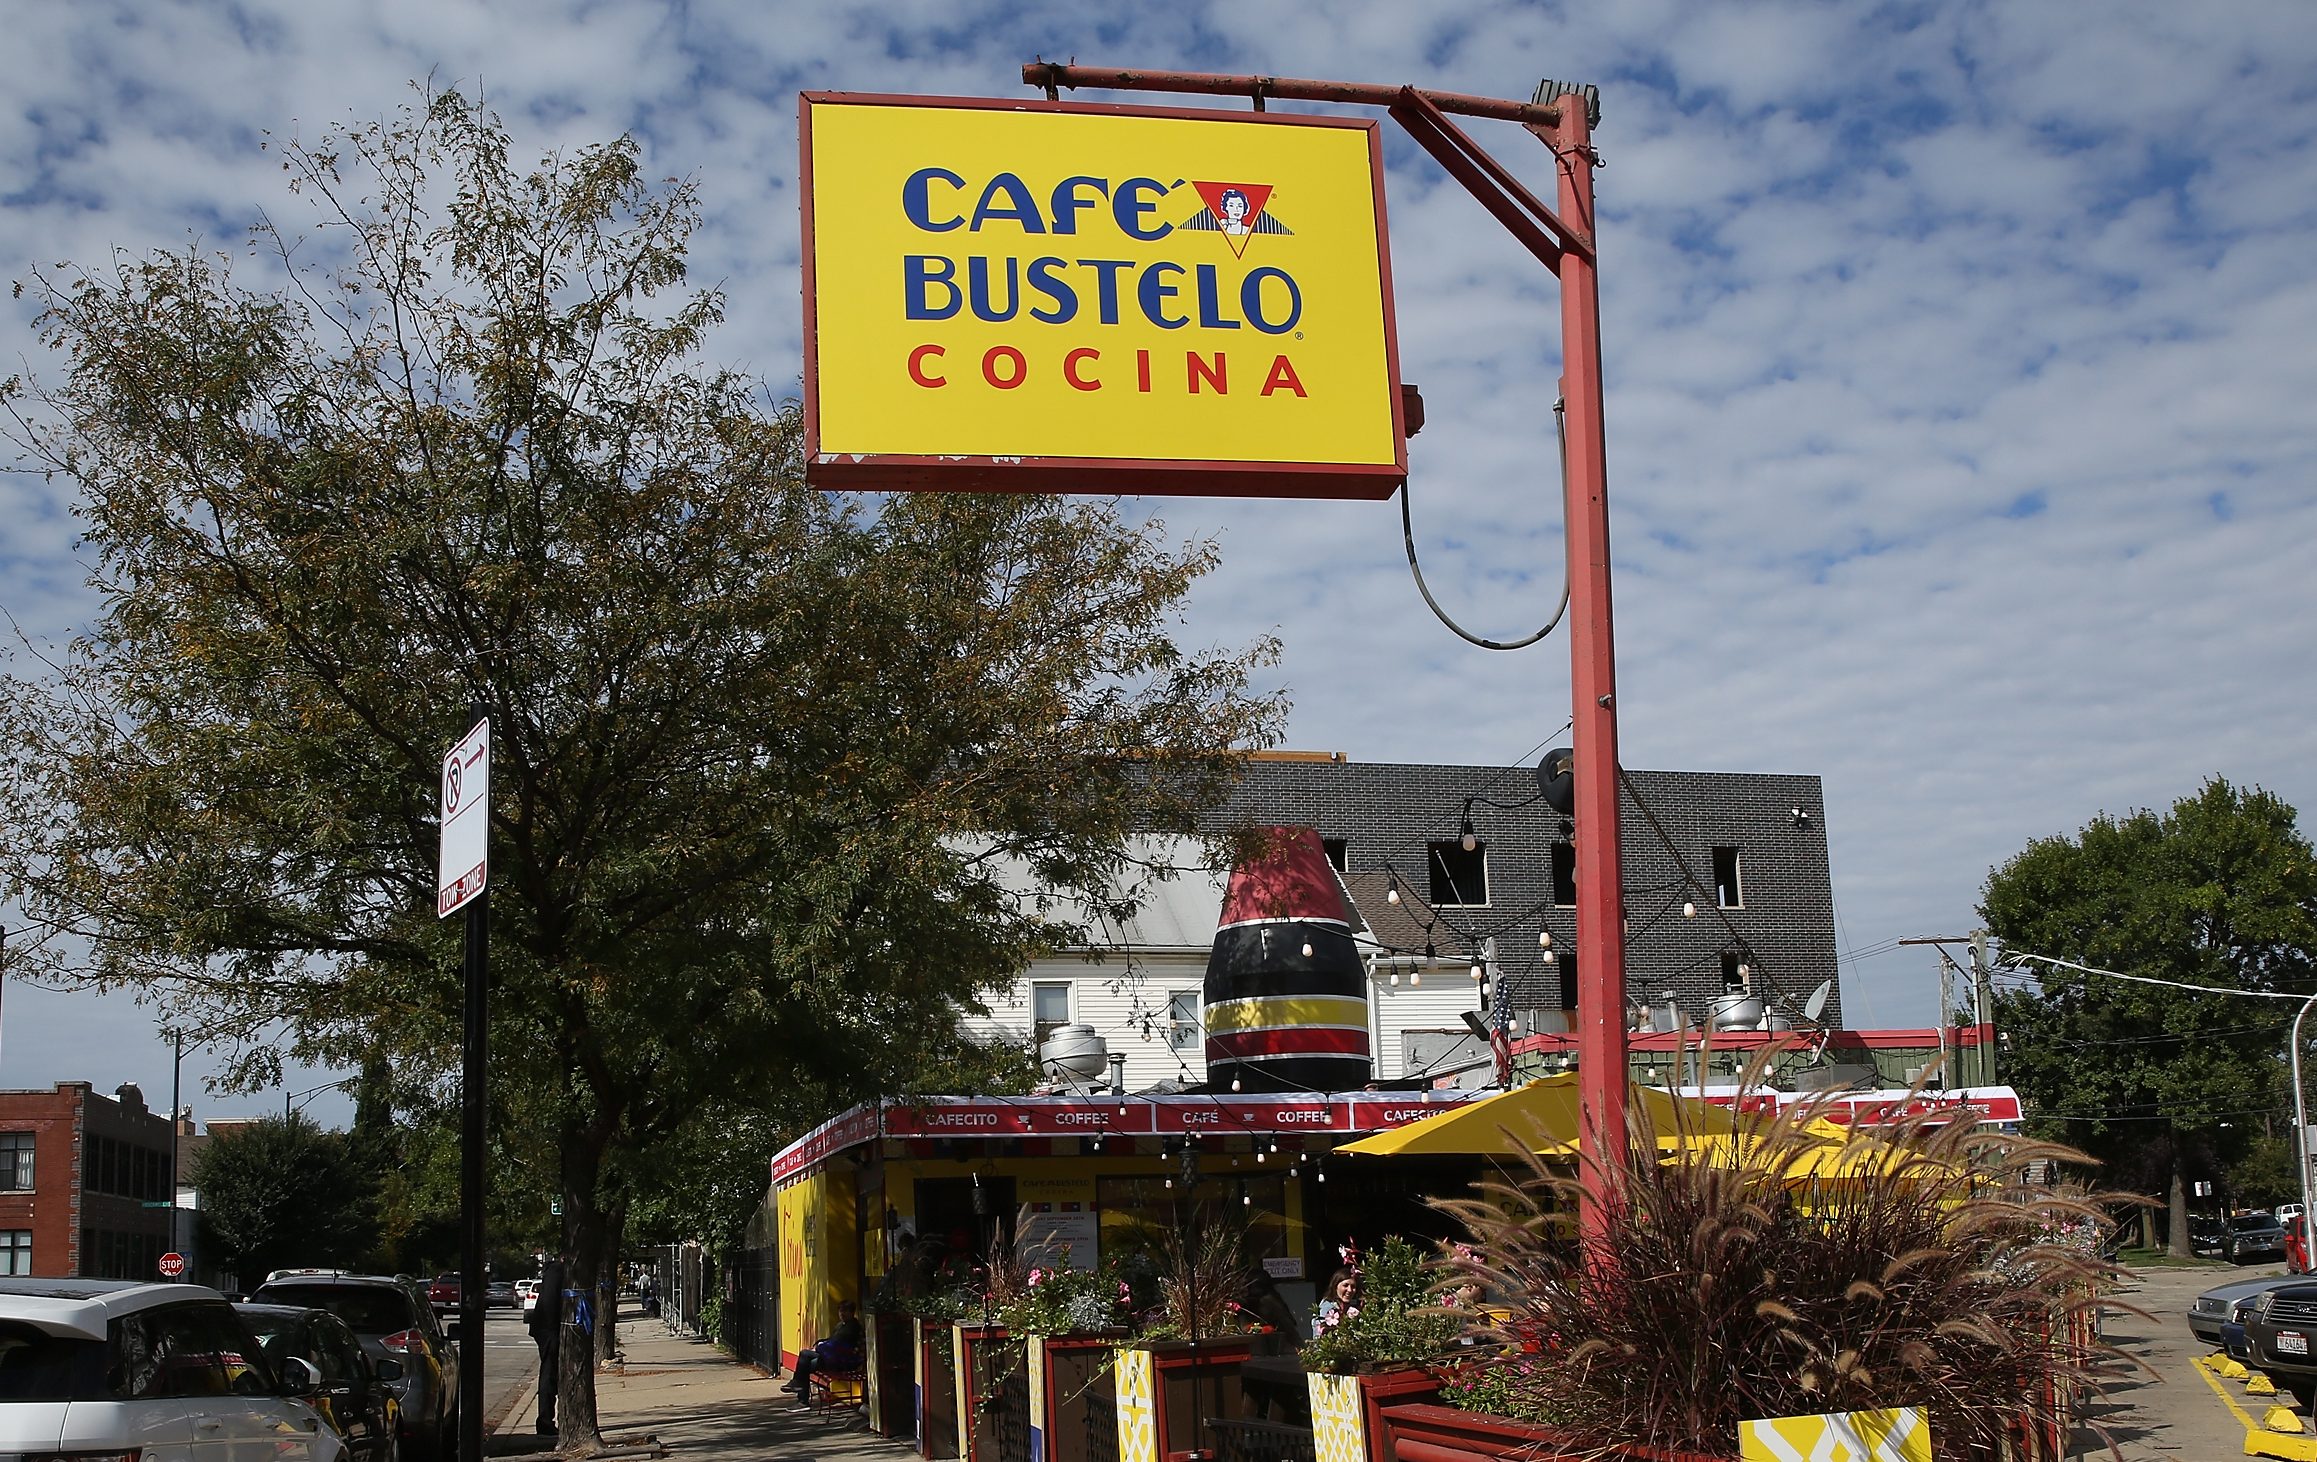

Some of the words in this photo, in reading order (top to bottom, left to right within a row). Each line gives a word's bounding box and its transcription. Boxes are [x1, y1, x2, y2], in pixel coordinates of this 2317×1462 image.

[902, 167, 1187, 242] CAFÉ
[903, 254, 1303, 336] BUSTELO
[907, 343, 1309, 398] COCINA
[926, 1113, 998, 1126] CAFECITO
[1055, 1112, 1109, 1125] COFFEE
[1182, 1108, 1219, 1124] CAFÉ
[161, 1259, 182, 1269] STOP
